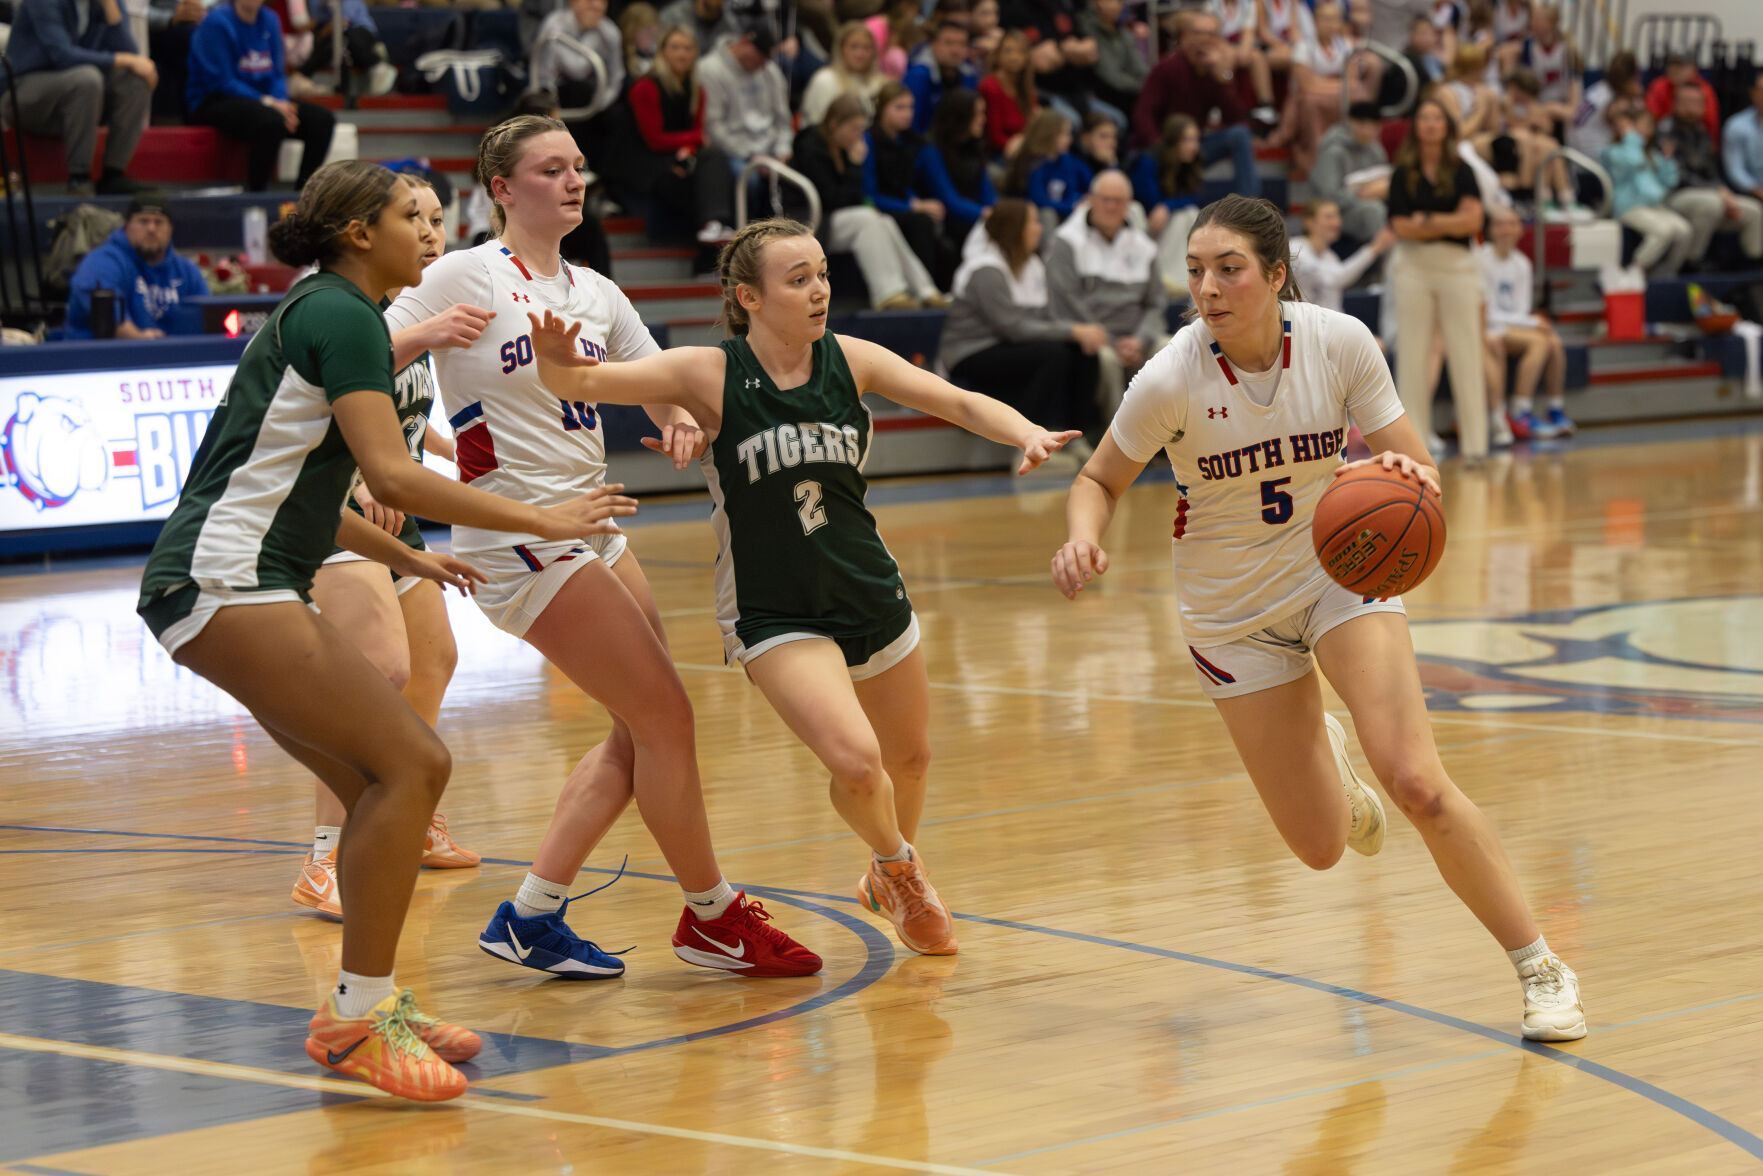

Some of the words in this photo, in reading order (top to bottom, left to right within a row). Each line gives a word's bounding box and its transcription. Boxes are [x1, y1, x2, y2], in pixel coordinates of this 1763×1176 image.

[120, 378, 215, 403] SOUTH
[737, 422, 859, 485] TIGERS
[1197, 437, 1285, 481] SOUTH
[1289, 427, 1344, 463] HIGH
[793, 479, 828, 536] 2
[1260, 476, 1293, 525] 5
